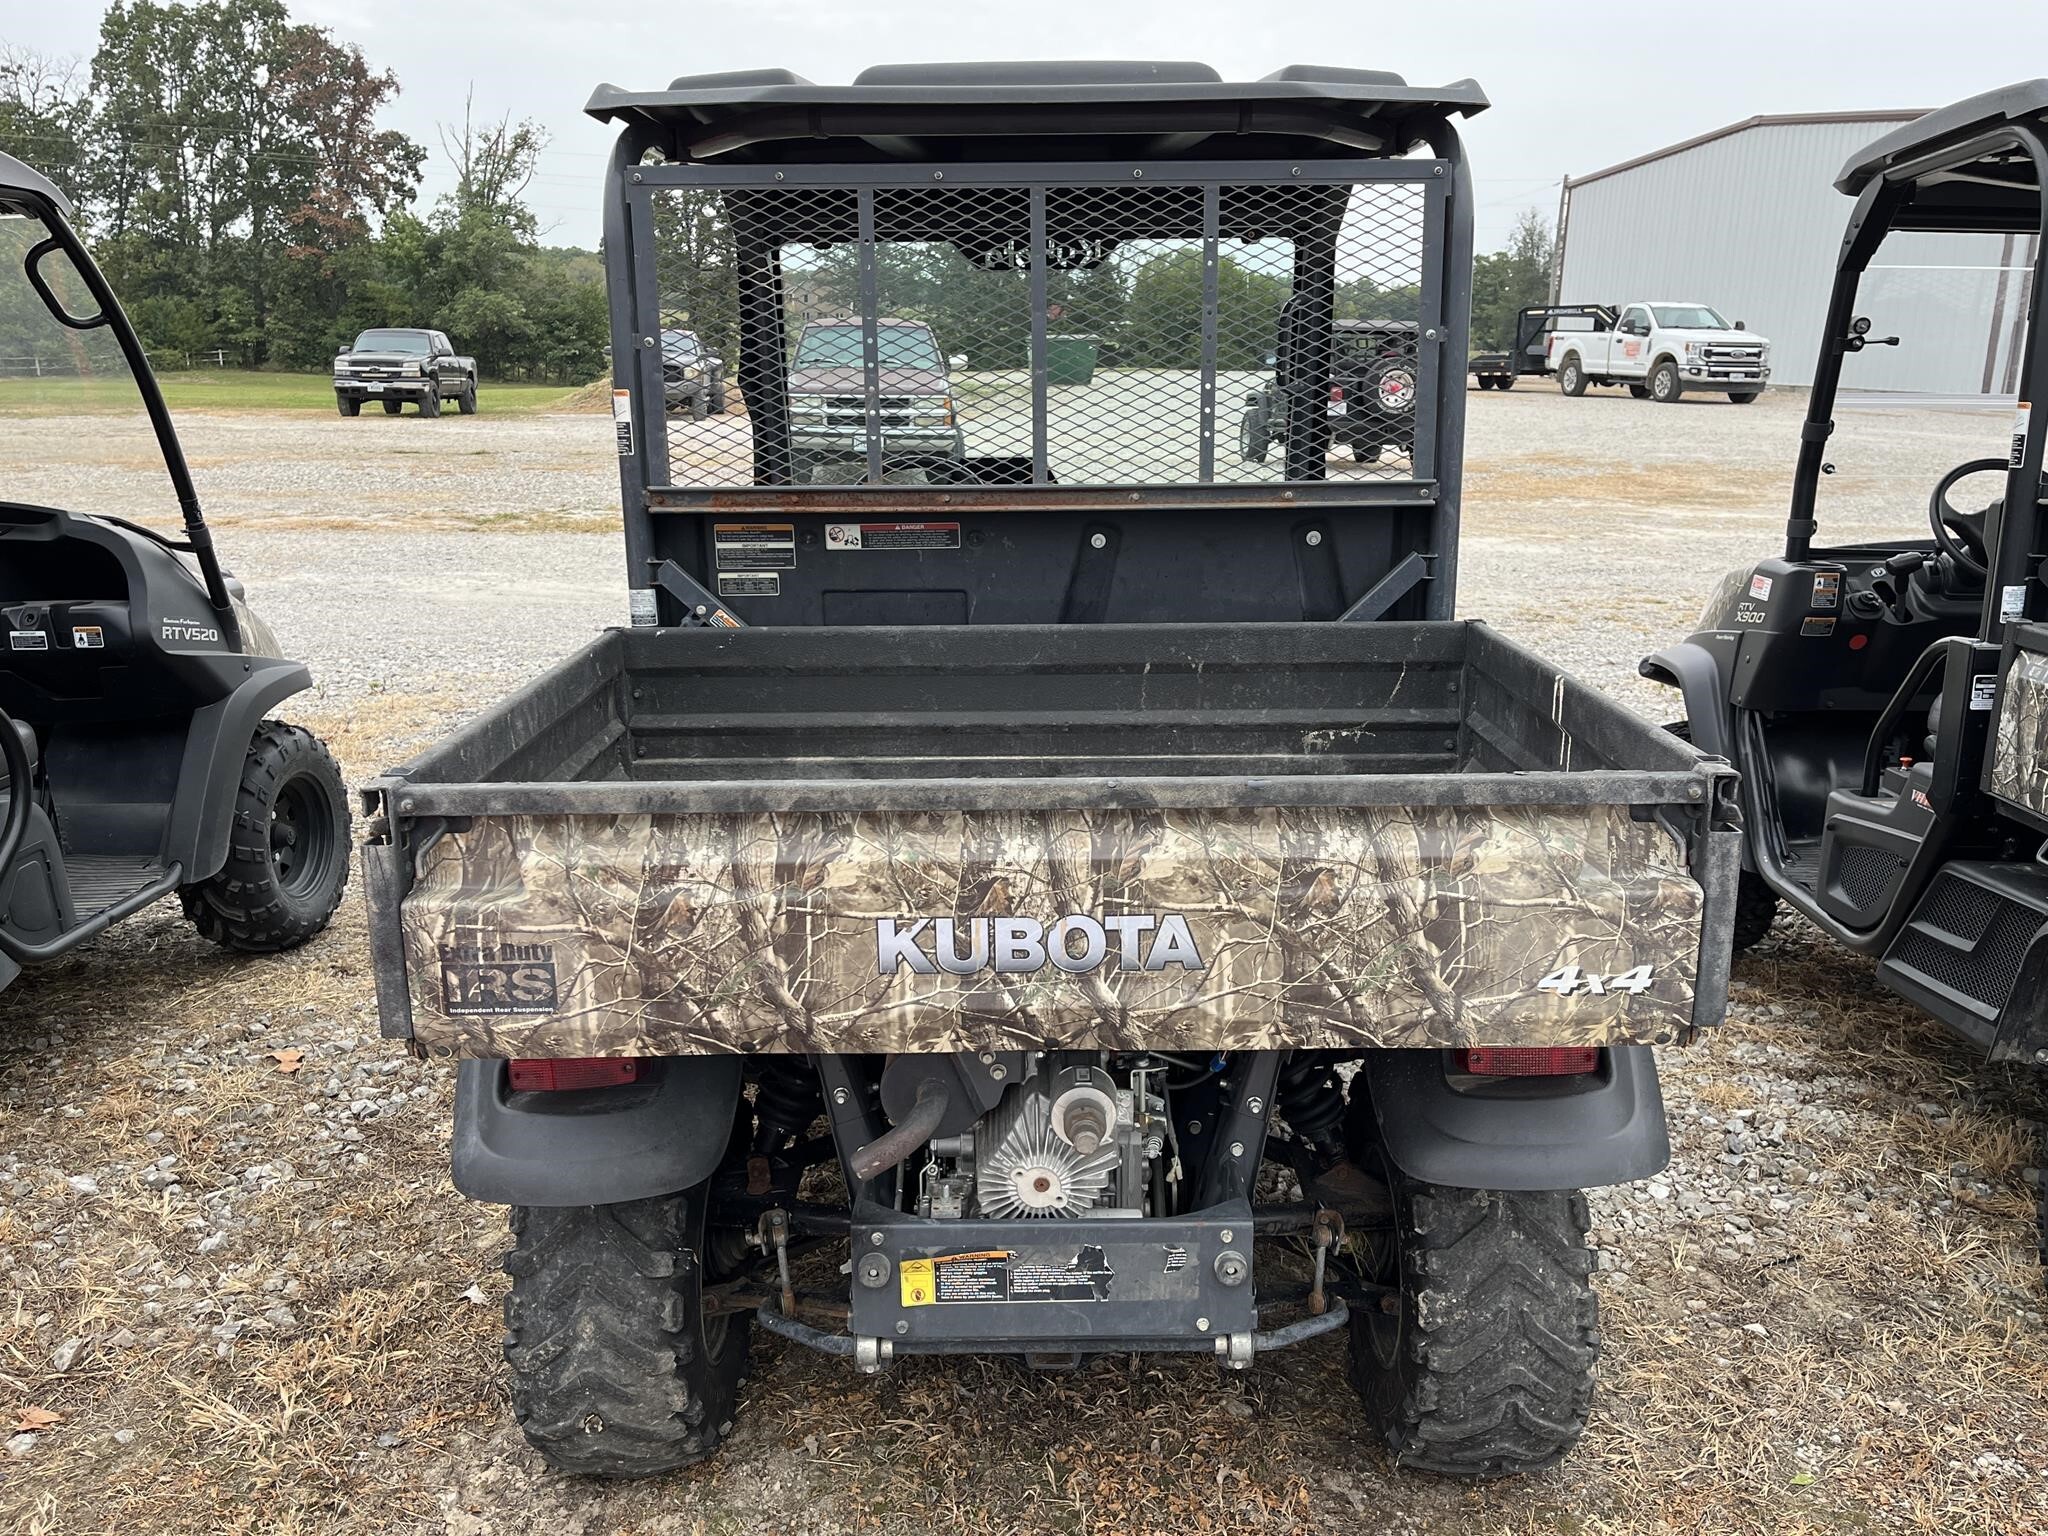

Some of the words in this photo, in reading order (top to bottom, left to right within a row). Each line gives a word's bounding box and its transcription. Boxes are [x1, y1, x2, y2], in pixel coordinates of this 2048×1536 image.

[1739, 602, 1756, 611] RTV
[1735, 611, 1766, 623] X900
[162, 626, 218, 641] RTV520
[876, 913, 1204, 975] KUBOTA
[500, 942, 553, 962] Duty
[446, 967, 555, 1003] IRS
[1537, 964, 1656, 996] 4x4
[449, 1007, 493, 1015] Independent
[513, 1006, 554, 1014] Suspension
[958, 1252, 991, 1260] WARNING
